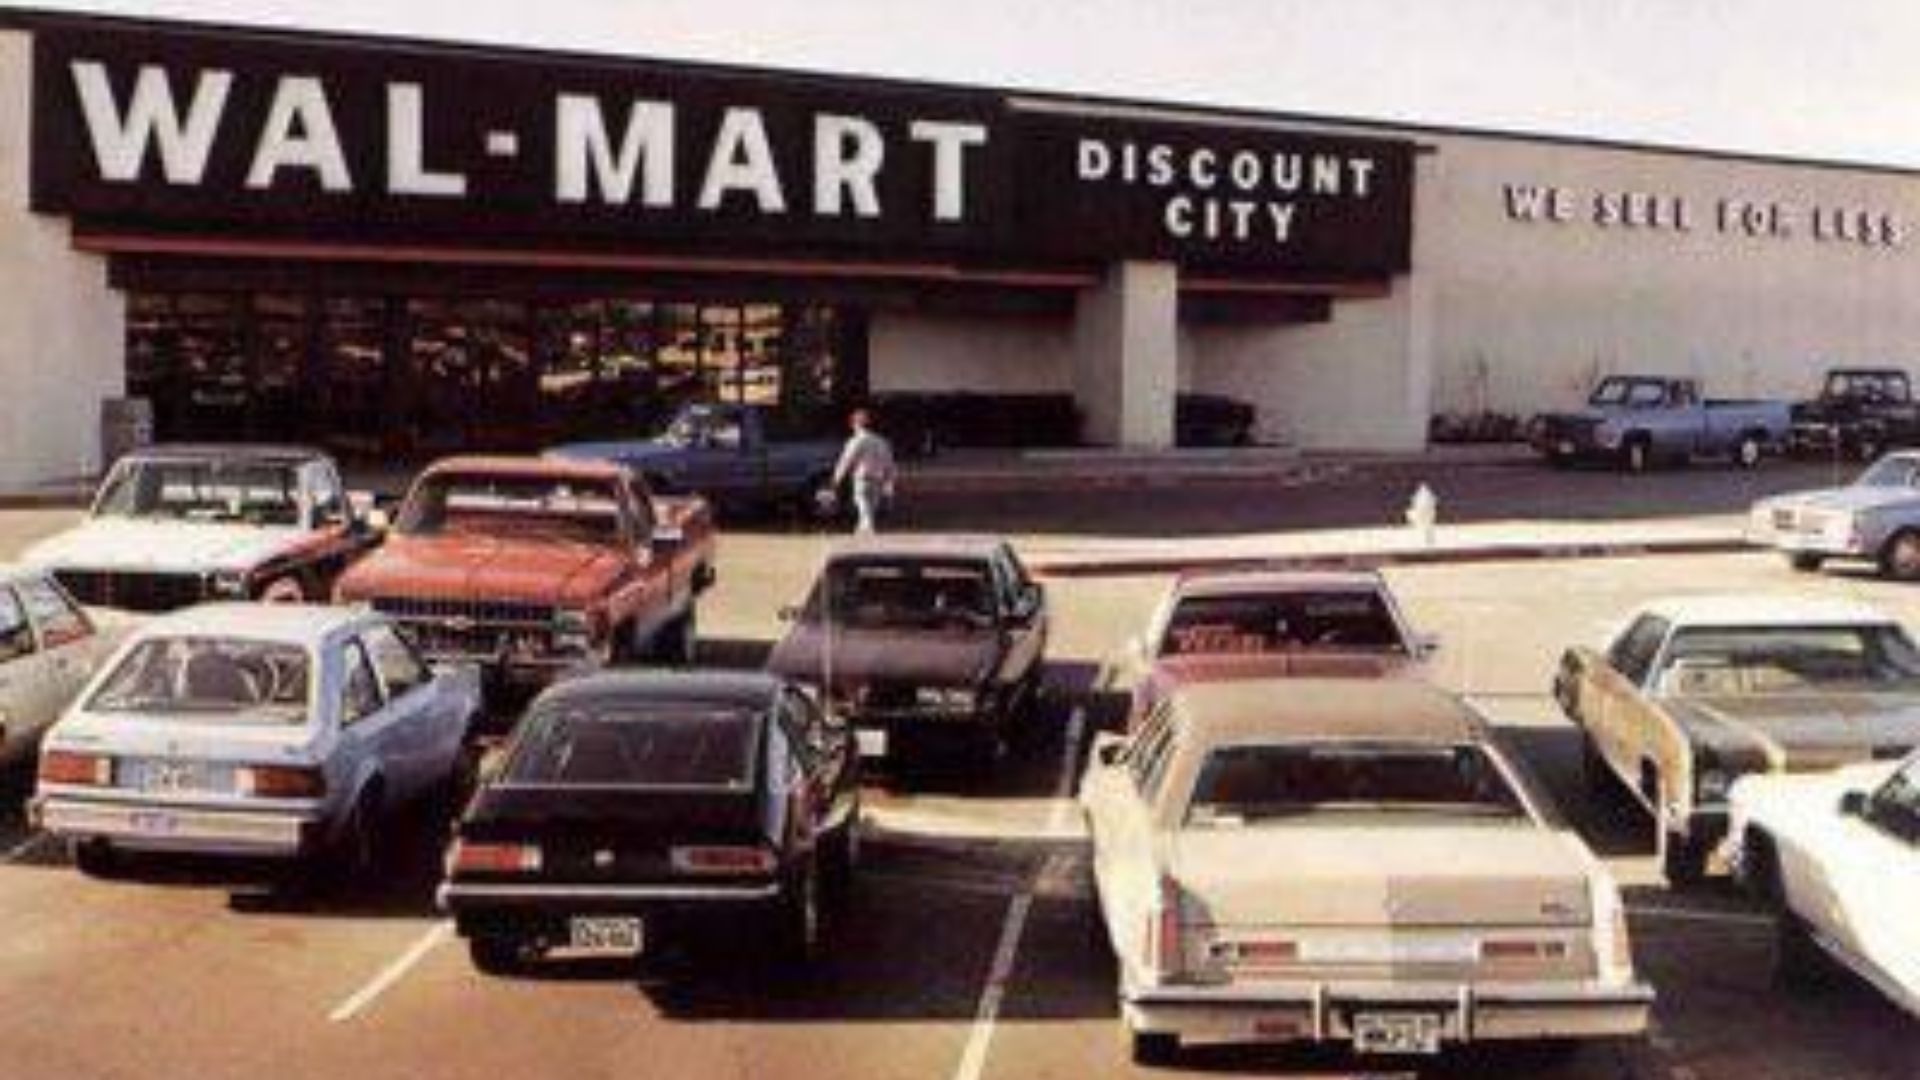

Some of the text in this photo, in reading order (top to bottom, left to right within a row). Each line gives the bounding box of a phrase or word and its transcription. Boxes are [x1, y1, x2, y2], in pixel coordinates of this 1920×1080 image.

[71, 61, 987, 220] WAL-MART
[1078, 139, 1374, 194] DISCOUNT
[1165, 197, 1294, 241] CITY
[1503, 184, 1902, 246] WE SELL FOR LESS
